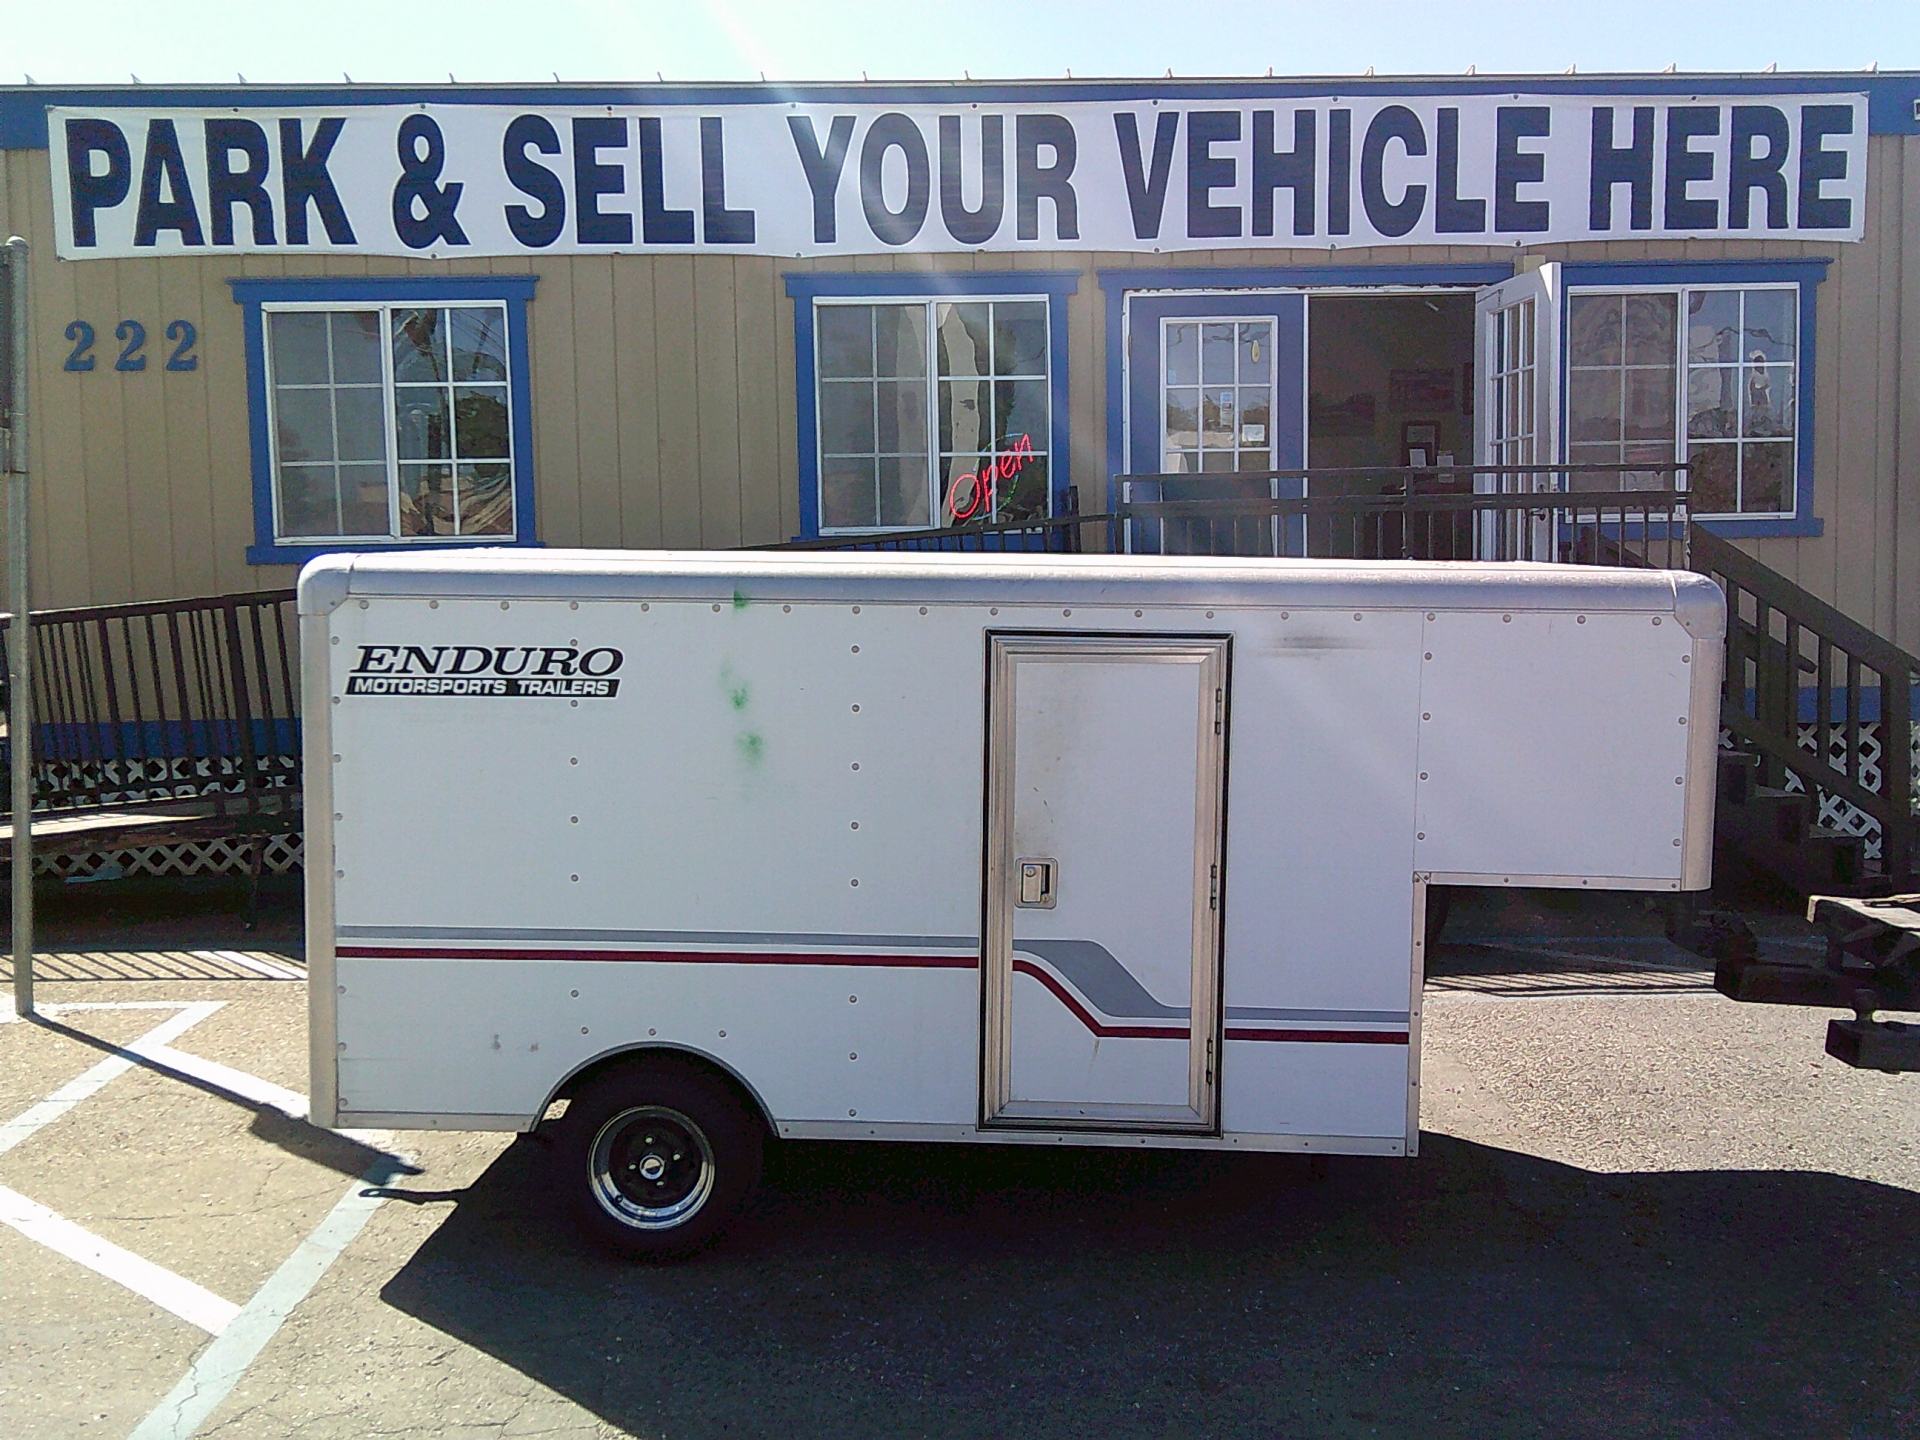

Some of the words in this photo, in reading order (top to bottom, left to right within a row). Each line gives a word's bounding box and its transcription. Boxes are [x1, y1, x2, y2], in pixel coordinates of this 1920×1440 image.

[65, 117, 358, 247] PARK
[393, 114, 470, 249] &
[503, 115, 756, 247] SELL
[786, 113, 1080, 245] YOUR
[1113, 105, 1551, 239] VEHICLE
[1589, 105, 1853, 231] HERE
[64, 319, 198, 371] 222
[350, 645, 623, 676] ENDURO
[354, 678, 507, 694] MOTORSPORTS
[517, 680, 609, 695] TRAILERS
